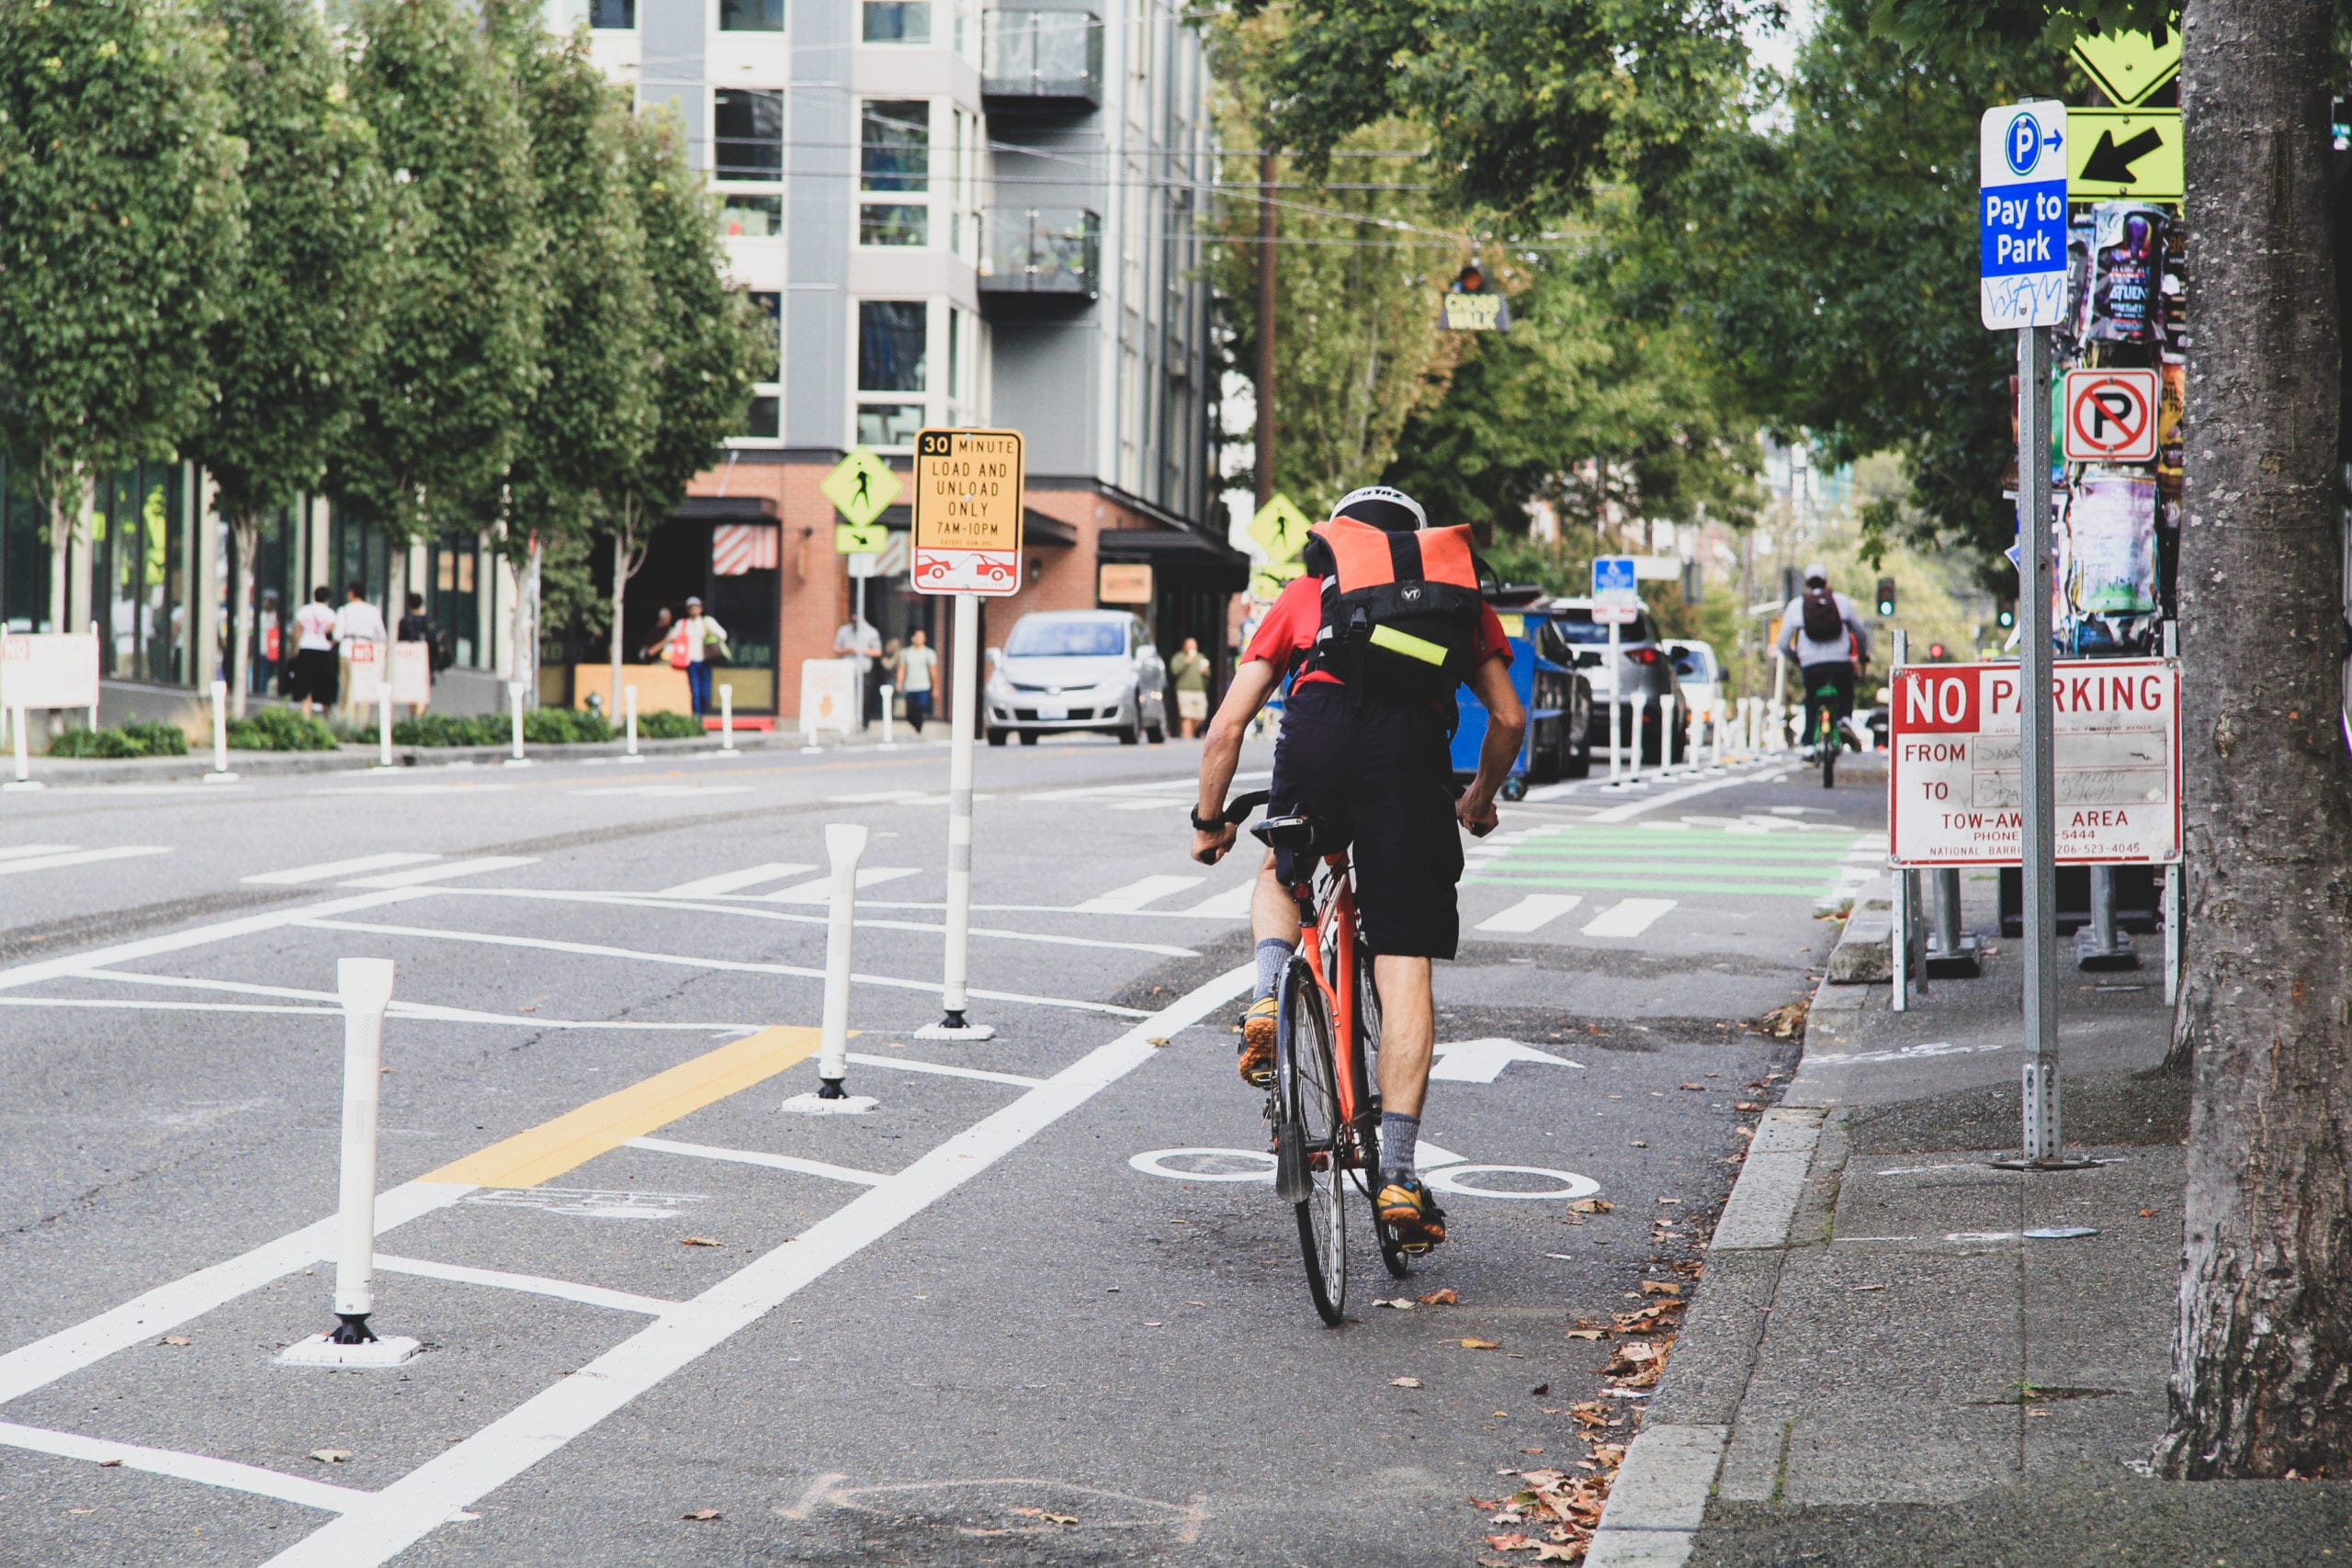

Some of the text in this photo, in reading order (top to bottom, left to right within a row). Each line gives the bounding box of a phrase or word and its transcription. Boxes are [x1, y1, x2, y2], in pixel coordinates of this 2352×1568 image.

[1986, 191, 2062, 231] Pay to
[1996, 230, 2052, 265] Park
[1444, 293, 1500, 314] CROSS
[1447, 311, 1497, 331] WALK
[923, 436, 1013, 455] 30 MINUTE
[932, 461, 1007, 478] LOAD AND
[936, 480, 1000, 497] UNLOAD
[948, 502, 989, 517] ONLY
[936, 522, 999, 536] 7AM-10PM
[1905, 674, 2162, 725] NO PRKING
[1905, 743, 1965, 762] FROM
[1922, 782, 1949, 801] TO
[1941, 810, 2129, 830] TOW-AW AREA
[1973, 830, 2019, 841] PHONE
[1929, 841, 2141, 856] NATIONAL BARRI 206-523-4045
